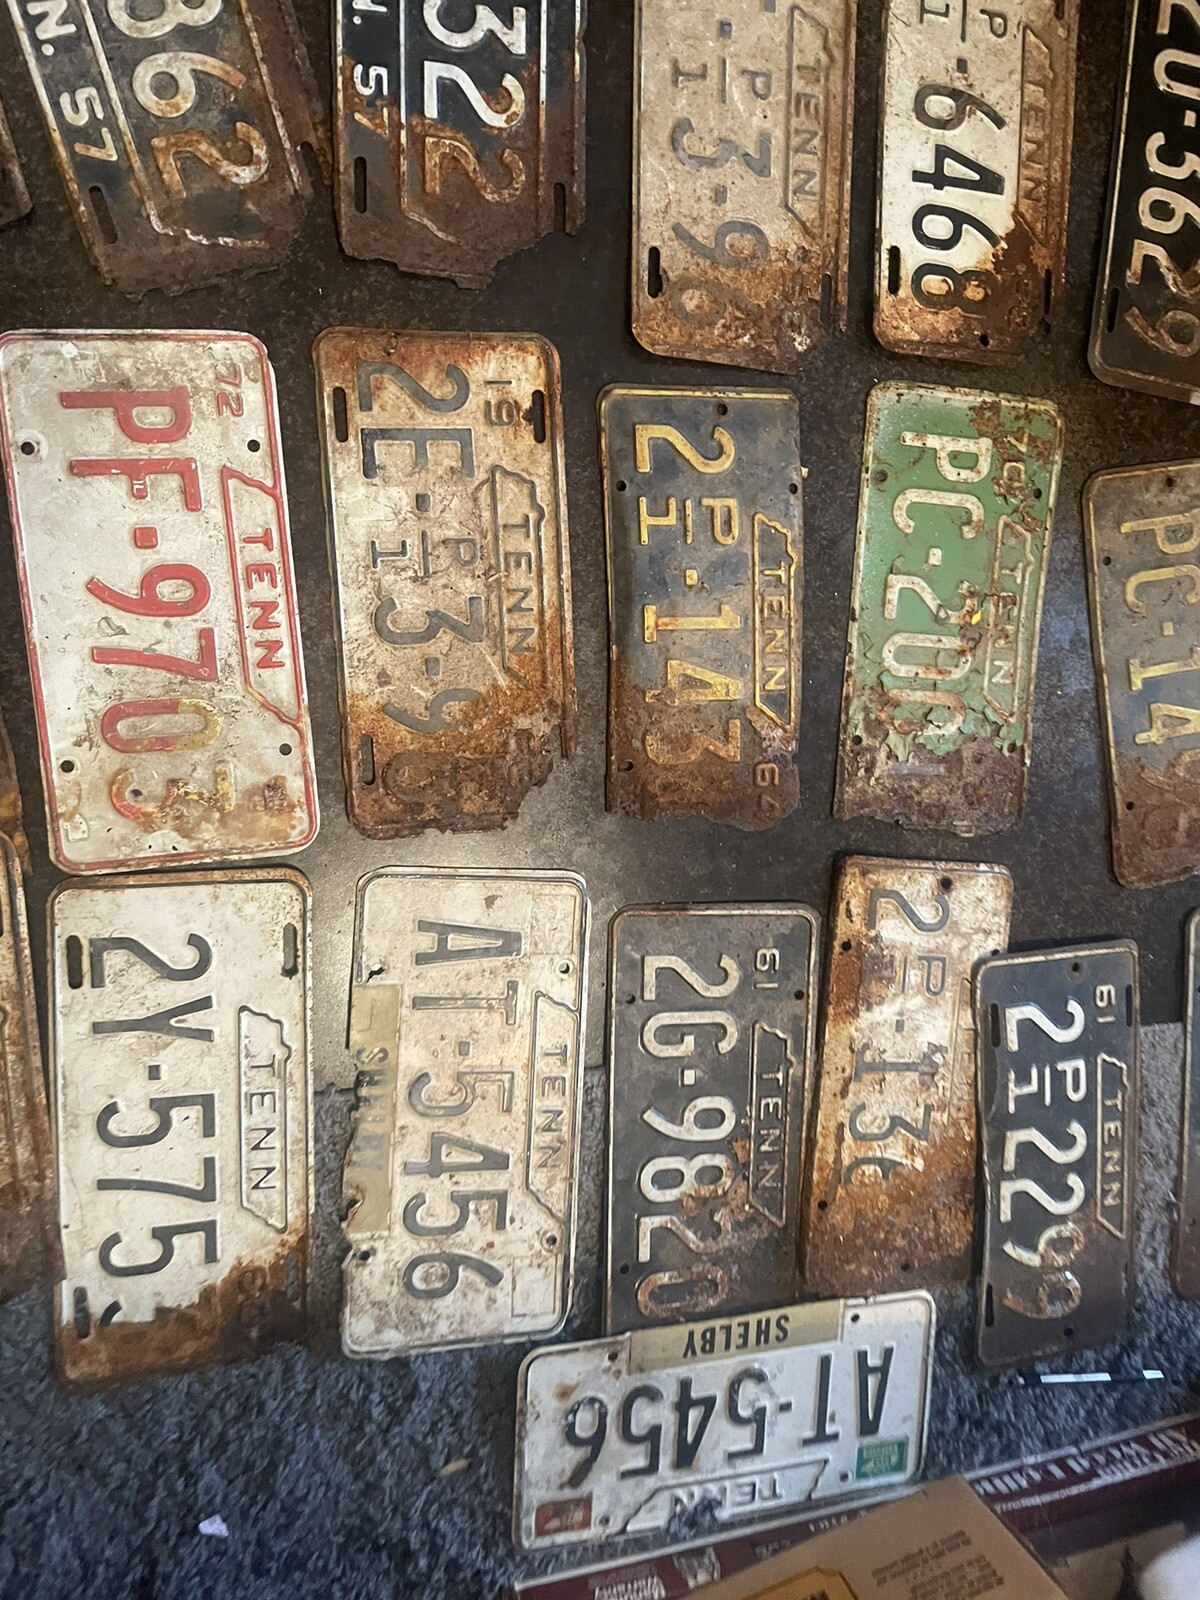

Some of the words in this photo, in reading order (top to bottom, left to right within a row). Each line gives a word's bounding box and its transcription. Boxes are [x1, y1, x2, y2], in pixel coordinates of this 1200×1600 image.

[60, 86, 118, 162] 57
[353, 64, 390, 137] 57
[422, 0, 527, 203] 322
[791, 58, 823, 197] TENN
[1021, 72, 1052, 204] TENN
[215, 362, 244, 418] 72
[484, 379, 519, 428] 19
[241, 527, 286, 669] TENN
[502, 519, 534, 655] TENN
[762, 562, 788, 692] TENN
[990, 562, 1024, 686] TENN
[754, 946, 780, 990] 61
[1096, 985, 1116, 1024] 61
[247, 1053, 278, 1191] TENN
[403, 918, 524, 1299] AT-5456
[537, 1045, 569, 1169] TENN
[636, 953, 740, 1319] 2G-9820
[755, 1069, 783, 1188] TENN
[1101, 1093, 1124, 1208] TENN
[682, 1313, 790, 1358] SHELBY
[564, 1346, 894, 1488] AT-5456
